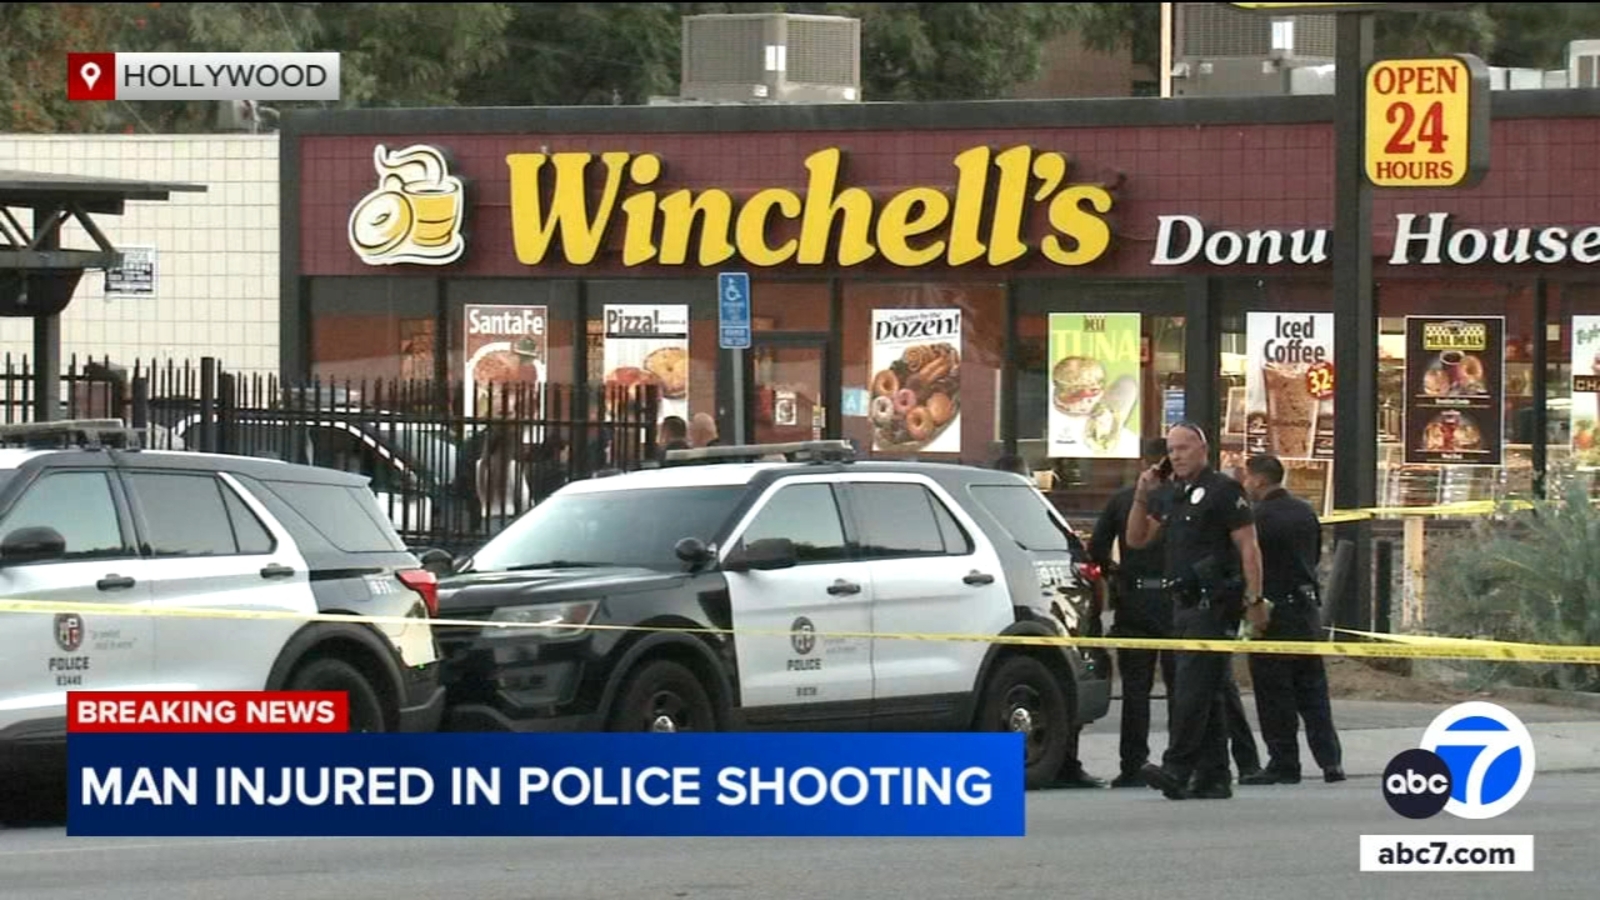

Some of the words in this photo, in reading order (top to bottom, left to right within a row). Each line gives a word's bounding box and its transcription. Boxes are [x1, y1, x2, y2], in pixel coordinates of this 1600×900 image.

[1373, 66, 1458, 95] OPEN
[1384, 101, 1449, 154] 24
[1376, 161, 1454, 180] HOURS
[506, 145, 1112, 267] Winchell's
[1151, 214, 1328, 266] Donu
[1388, 211, 1600, 266] House
[469, 309, 544, 335] SantaFe
[606, 309, 660, 334] Pizza!
[875, 313, 960, 341] Dozen!
[1275, 315, 1315, 339] Iced
[1053, 329, 1138, 362] TUNA
[1264, 339, 1326, 363] Coffee
[49, 656, 90, 671] POLICE
[787, 658, 822, 671] POLICE
